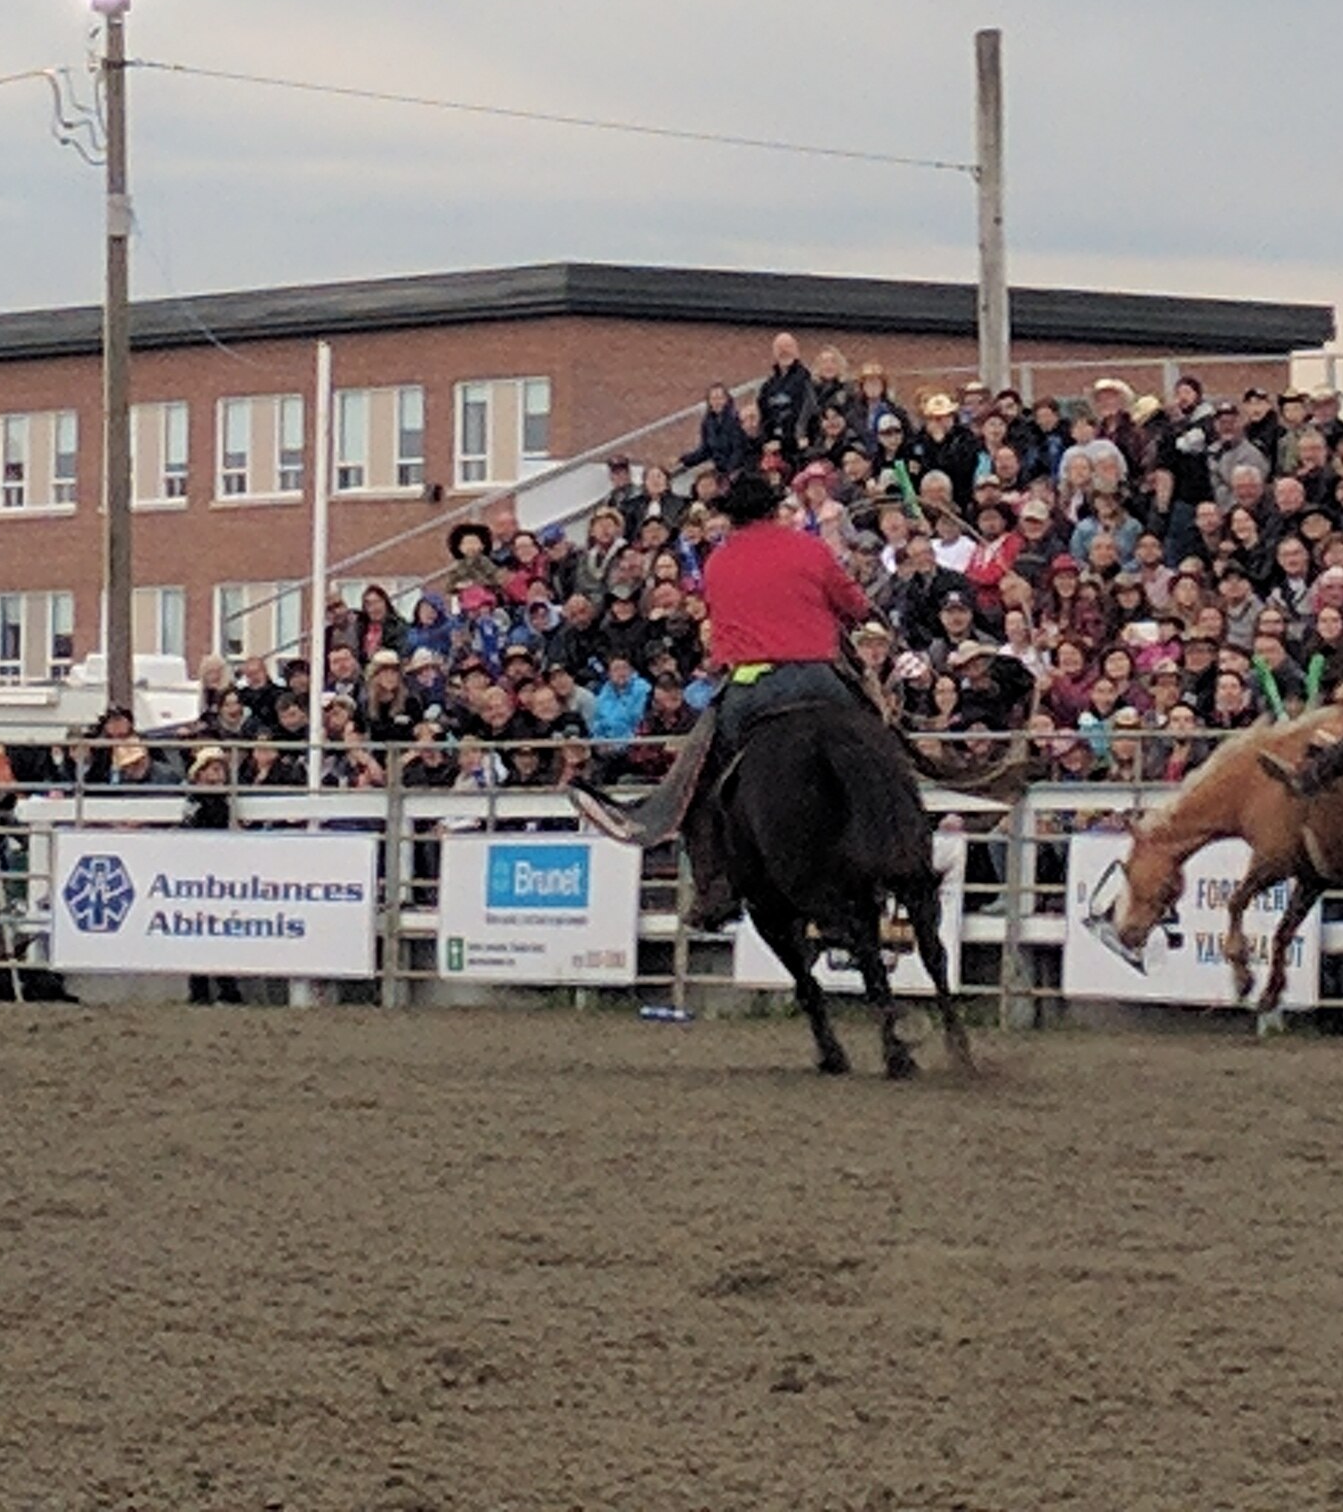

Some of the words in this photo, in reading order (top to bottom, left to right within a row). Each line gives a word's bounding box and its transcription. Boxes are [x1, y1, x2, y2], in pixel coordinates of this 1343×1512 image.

[146, 873, 365, 903] Ambulances
[514, 860, 583, 897] Brunet
[146, 910, 307, 938] Abitémis
